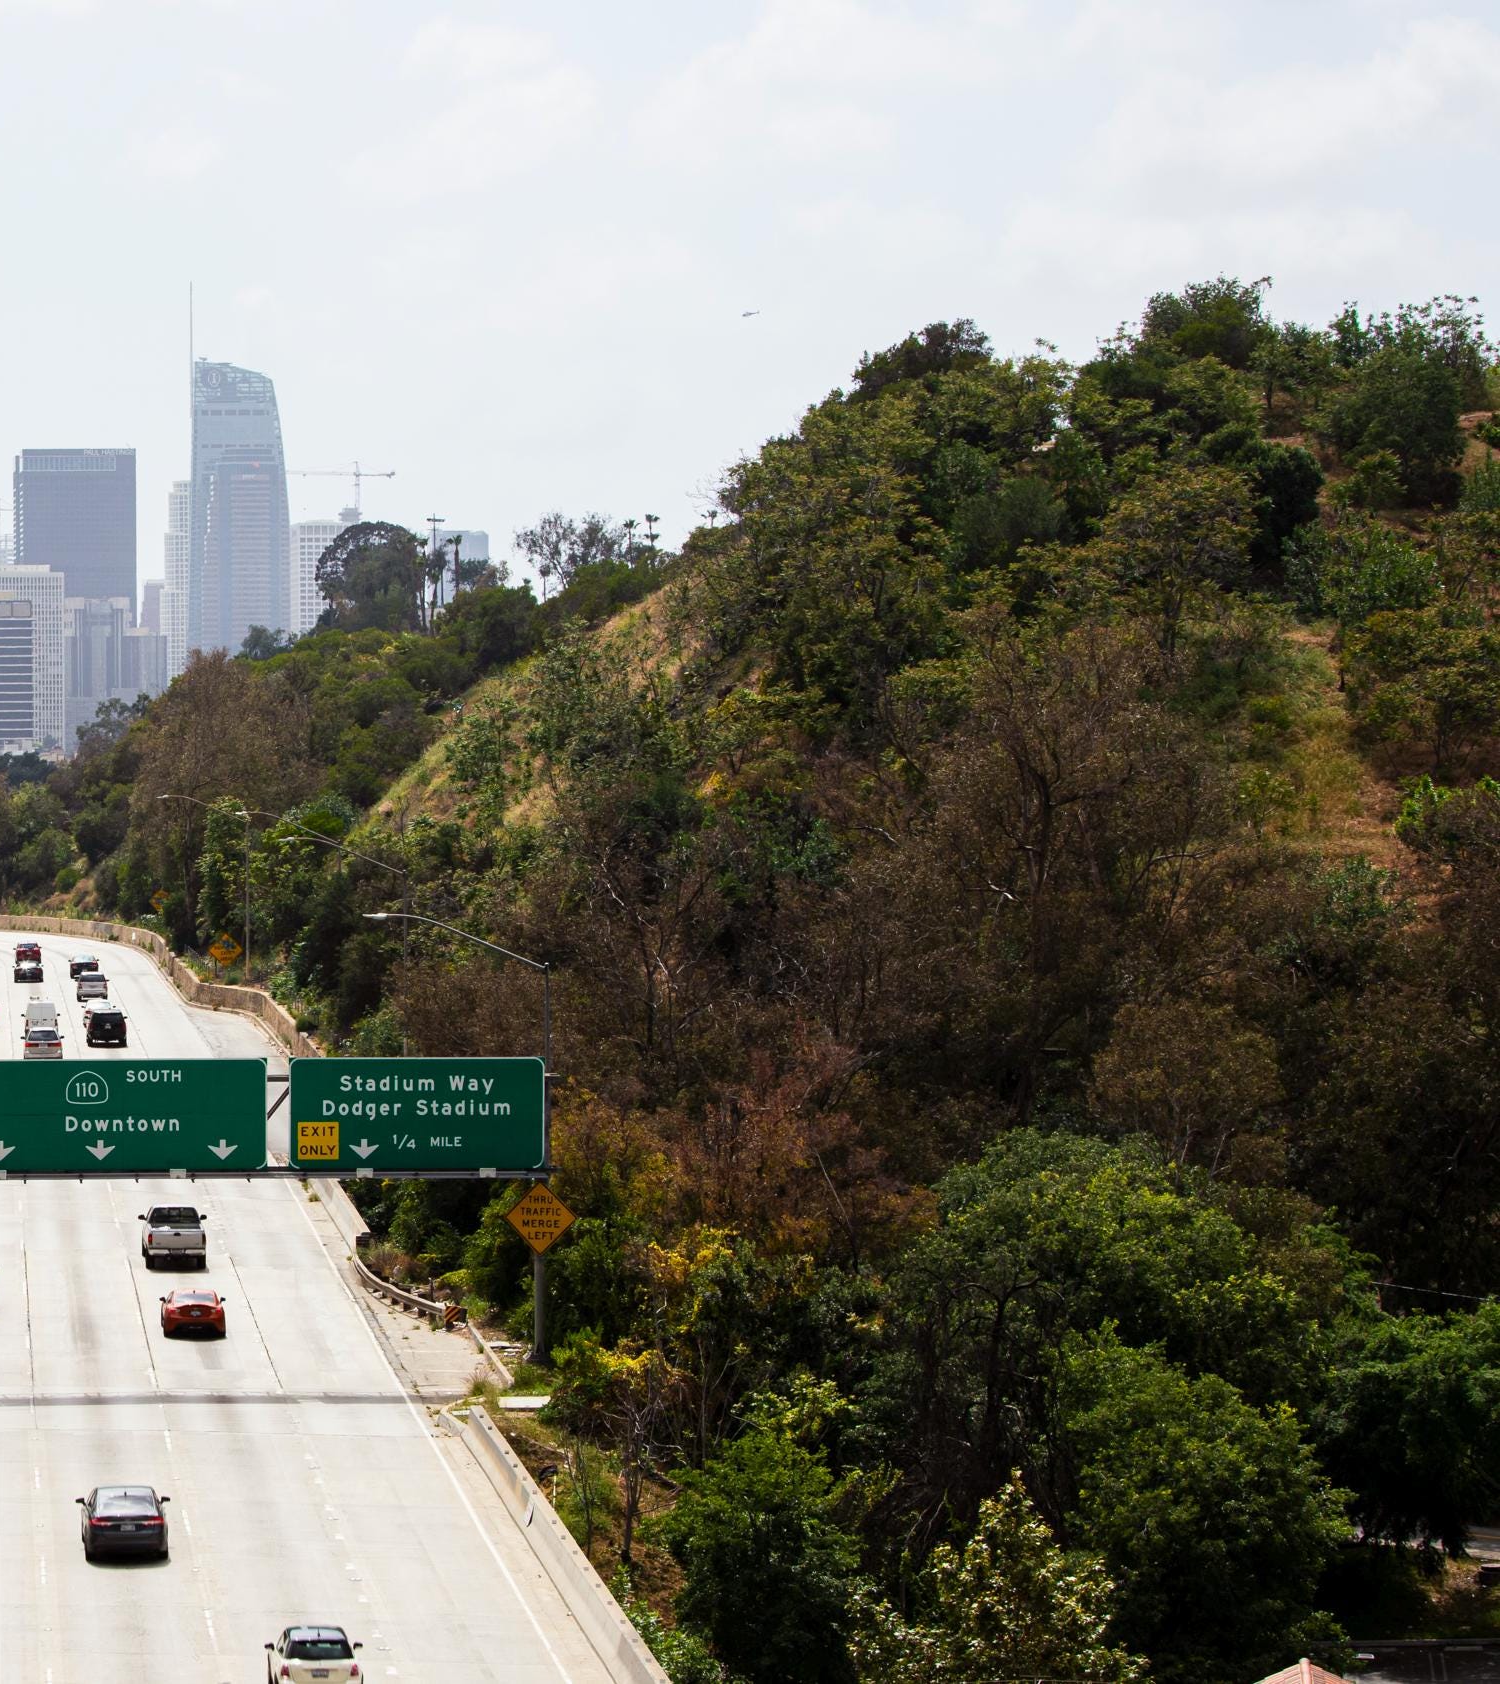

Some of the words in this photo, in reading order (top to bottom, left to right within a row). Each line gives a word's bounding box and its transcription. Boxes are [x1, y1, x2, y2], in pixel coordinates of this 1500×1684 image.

[126, 1070, 182, 1083] SOUTH
[75, 1082, 99, 1098] 110
[339, 1075, 435, 1092] Stadium
[449, 1075, 495, 1095] Way
[322, 1099, 402, 1120] Dodger
[416, 1100, 511, 1116] Stadium
[65, 1115, 180, 1132] Downtown
[301, 1126, 336, 1137] EXIT
[430, 1136, 462, 1147] MILE
[299, 1145, 336, 1155] ONLY
[528, 1195, 553, 1205] THRU
[521, 1207, 561, 1216] TRAFFIC
[522, 1219, 560, 1228] MERGE
[527, 1231, 555, 1240] LEFT
